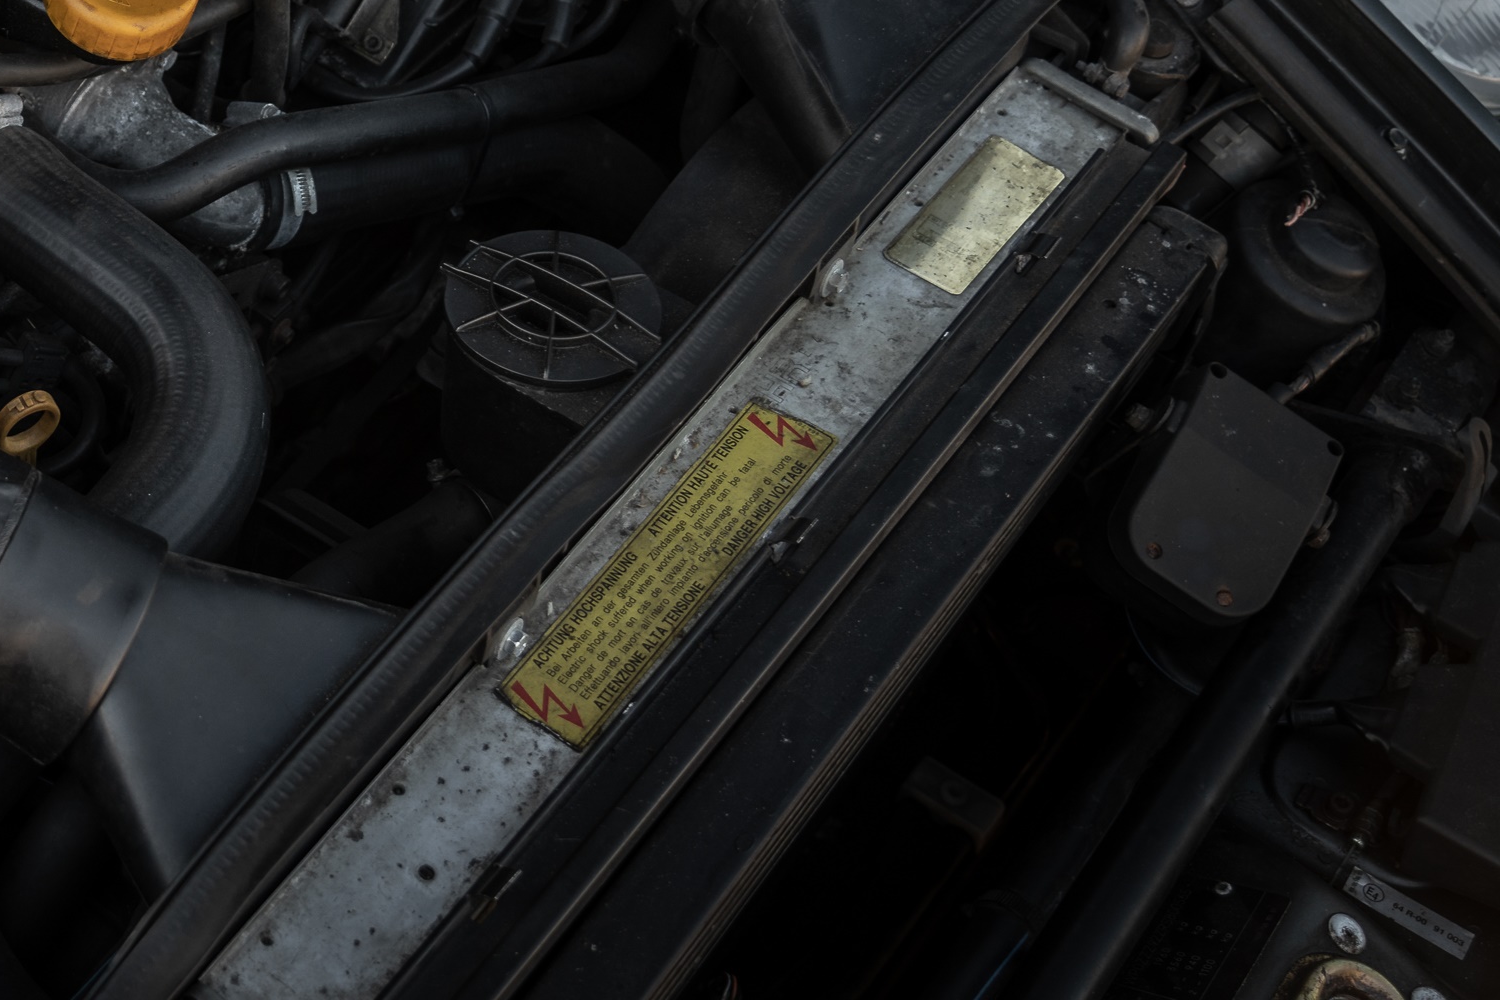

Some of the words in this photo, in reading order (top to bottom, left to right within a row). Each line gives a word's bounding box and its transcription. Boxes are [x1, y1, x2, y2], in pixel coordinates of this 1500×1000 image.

[6, 389, 47, 411] OIL
[647, 488, 694, 538] ATTENTION
[711, 425, 749, 462] TENSION
[721, 519, 758, 557] DANGER
[751, 498, 775, 522] HIGH
[768, 460, 808, 499] VOLTAGE
[533, 623, 576, 669] ACHTUNG
[569, 551, 638, 625] HOCHSPANNUNG
[545, 663, 562, 678] Bei
[561, 629, 592, 662] Arbeiten
[591, 616, 604, 628] an
[603, 600, 616, 614] der
[616, 562, 650, 600] gesamten
[684, 472, 728, 518] Lebensgefahr
[557, 656, 587, 685] Electric
[586, 630, 609, 654] shock
[608, 595, 637, 629] suffered
[635, 575, 656, 595] when
[655, 544, 684, 573] working
[681, 532, 694, 543] on
[690, 504, 717, 531] ignition
[716, 488, 731, 503] can
[727, 476, 741, 487] be
[738, 457, 757, 475] fatal
[568, 663, 597, 694] Danger
[596, 650, 609, 662] de
[607, 629, 626, 649] mort
[625, 617, 638, 628] en
[637, 600, 652, 615] cas
[651, 587, 663, 599] de
[661, 557, 688, 585] travaux
[687, 542, 701, 556] sur
[698, 505, 733, 541] l'allumage
[579, 656, 621, 700] Effettuando
[618, 632, 641, 654] lavori
[640, 598, 670, 631] all'intero
[667, 563, 700, 597] impianto
[738, 487, 765, 517] pericolo
[763, 476, 773, 486] di
[771, 455, 793, 476] morte
[594, 650, 647, 711] ATTENZIONE
[642, 626, 669, 653] ALTA
[661, 581, 706, 627] TENSIONE
[1366, 886, 1379, 901] E4
[1433, 925, 1445, 935] 91
